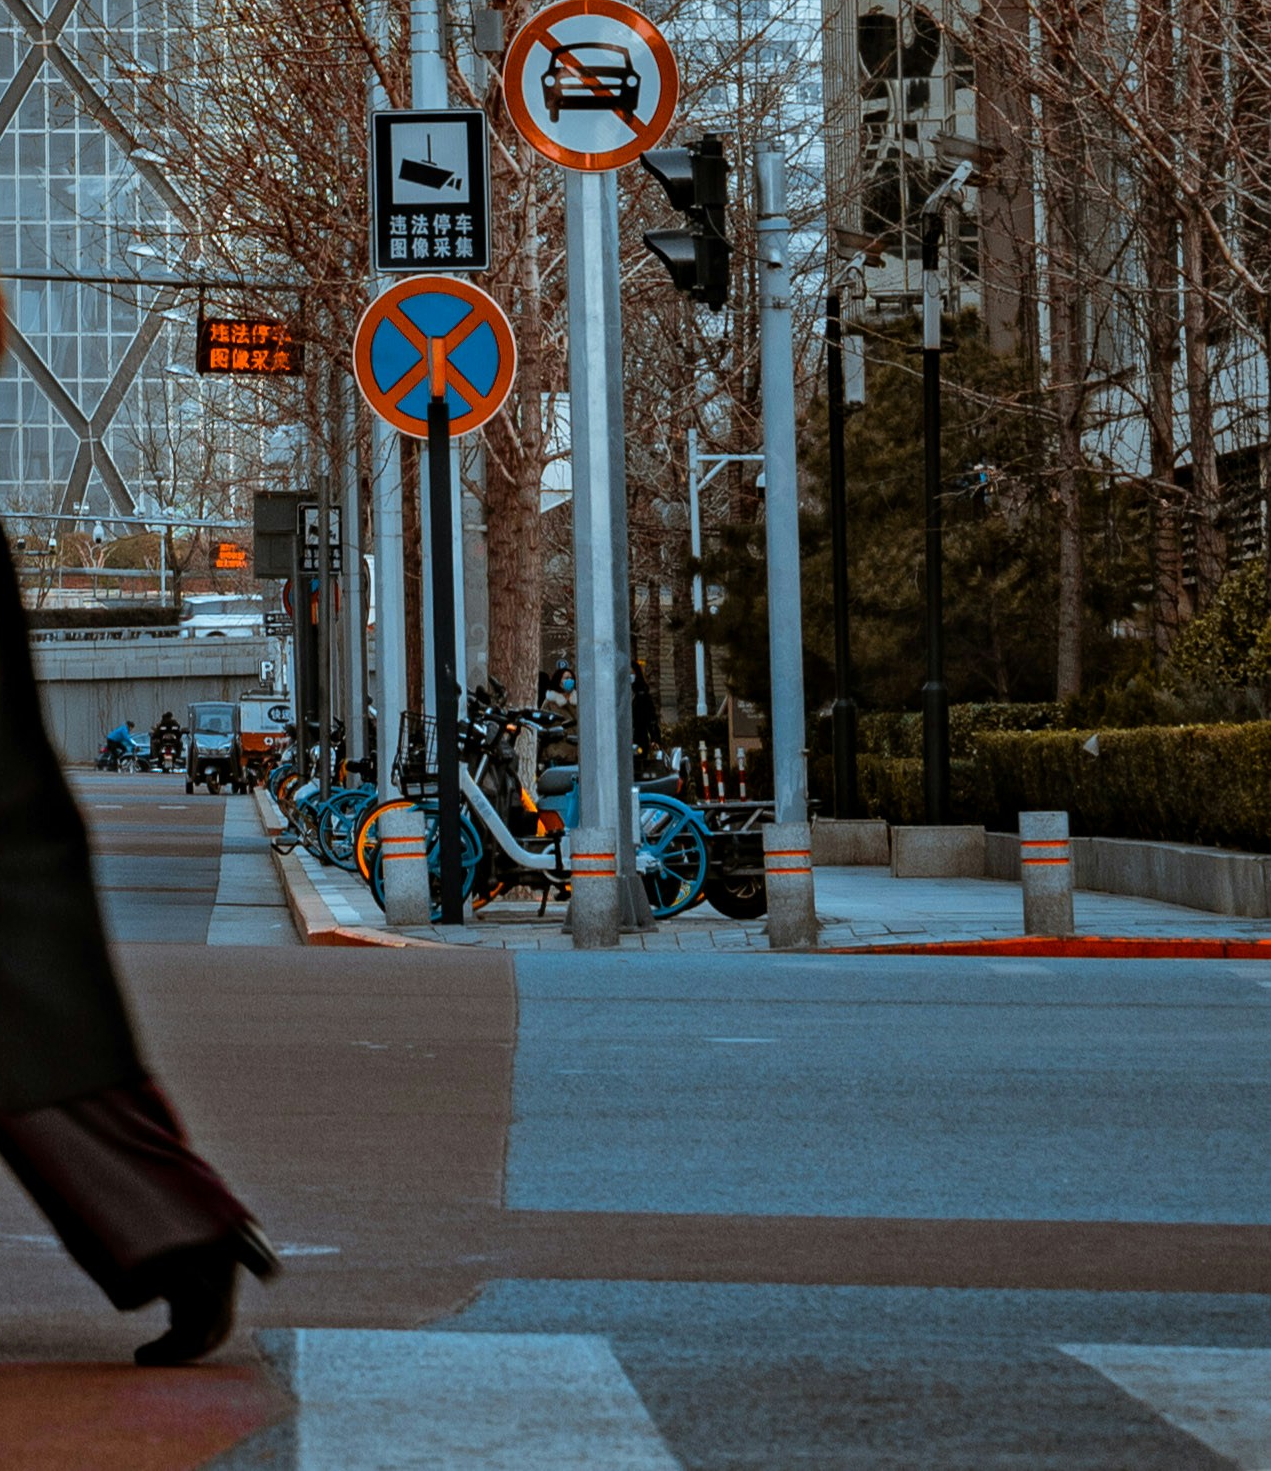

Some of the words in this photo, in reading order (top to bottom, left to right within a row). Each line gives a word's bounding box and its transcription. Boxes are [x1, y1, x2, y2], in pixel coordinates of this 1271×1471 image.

[389, 212, 473, 236] 违法停车
[389, 236, 473, 260] 图像采集
